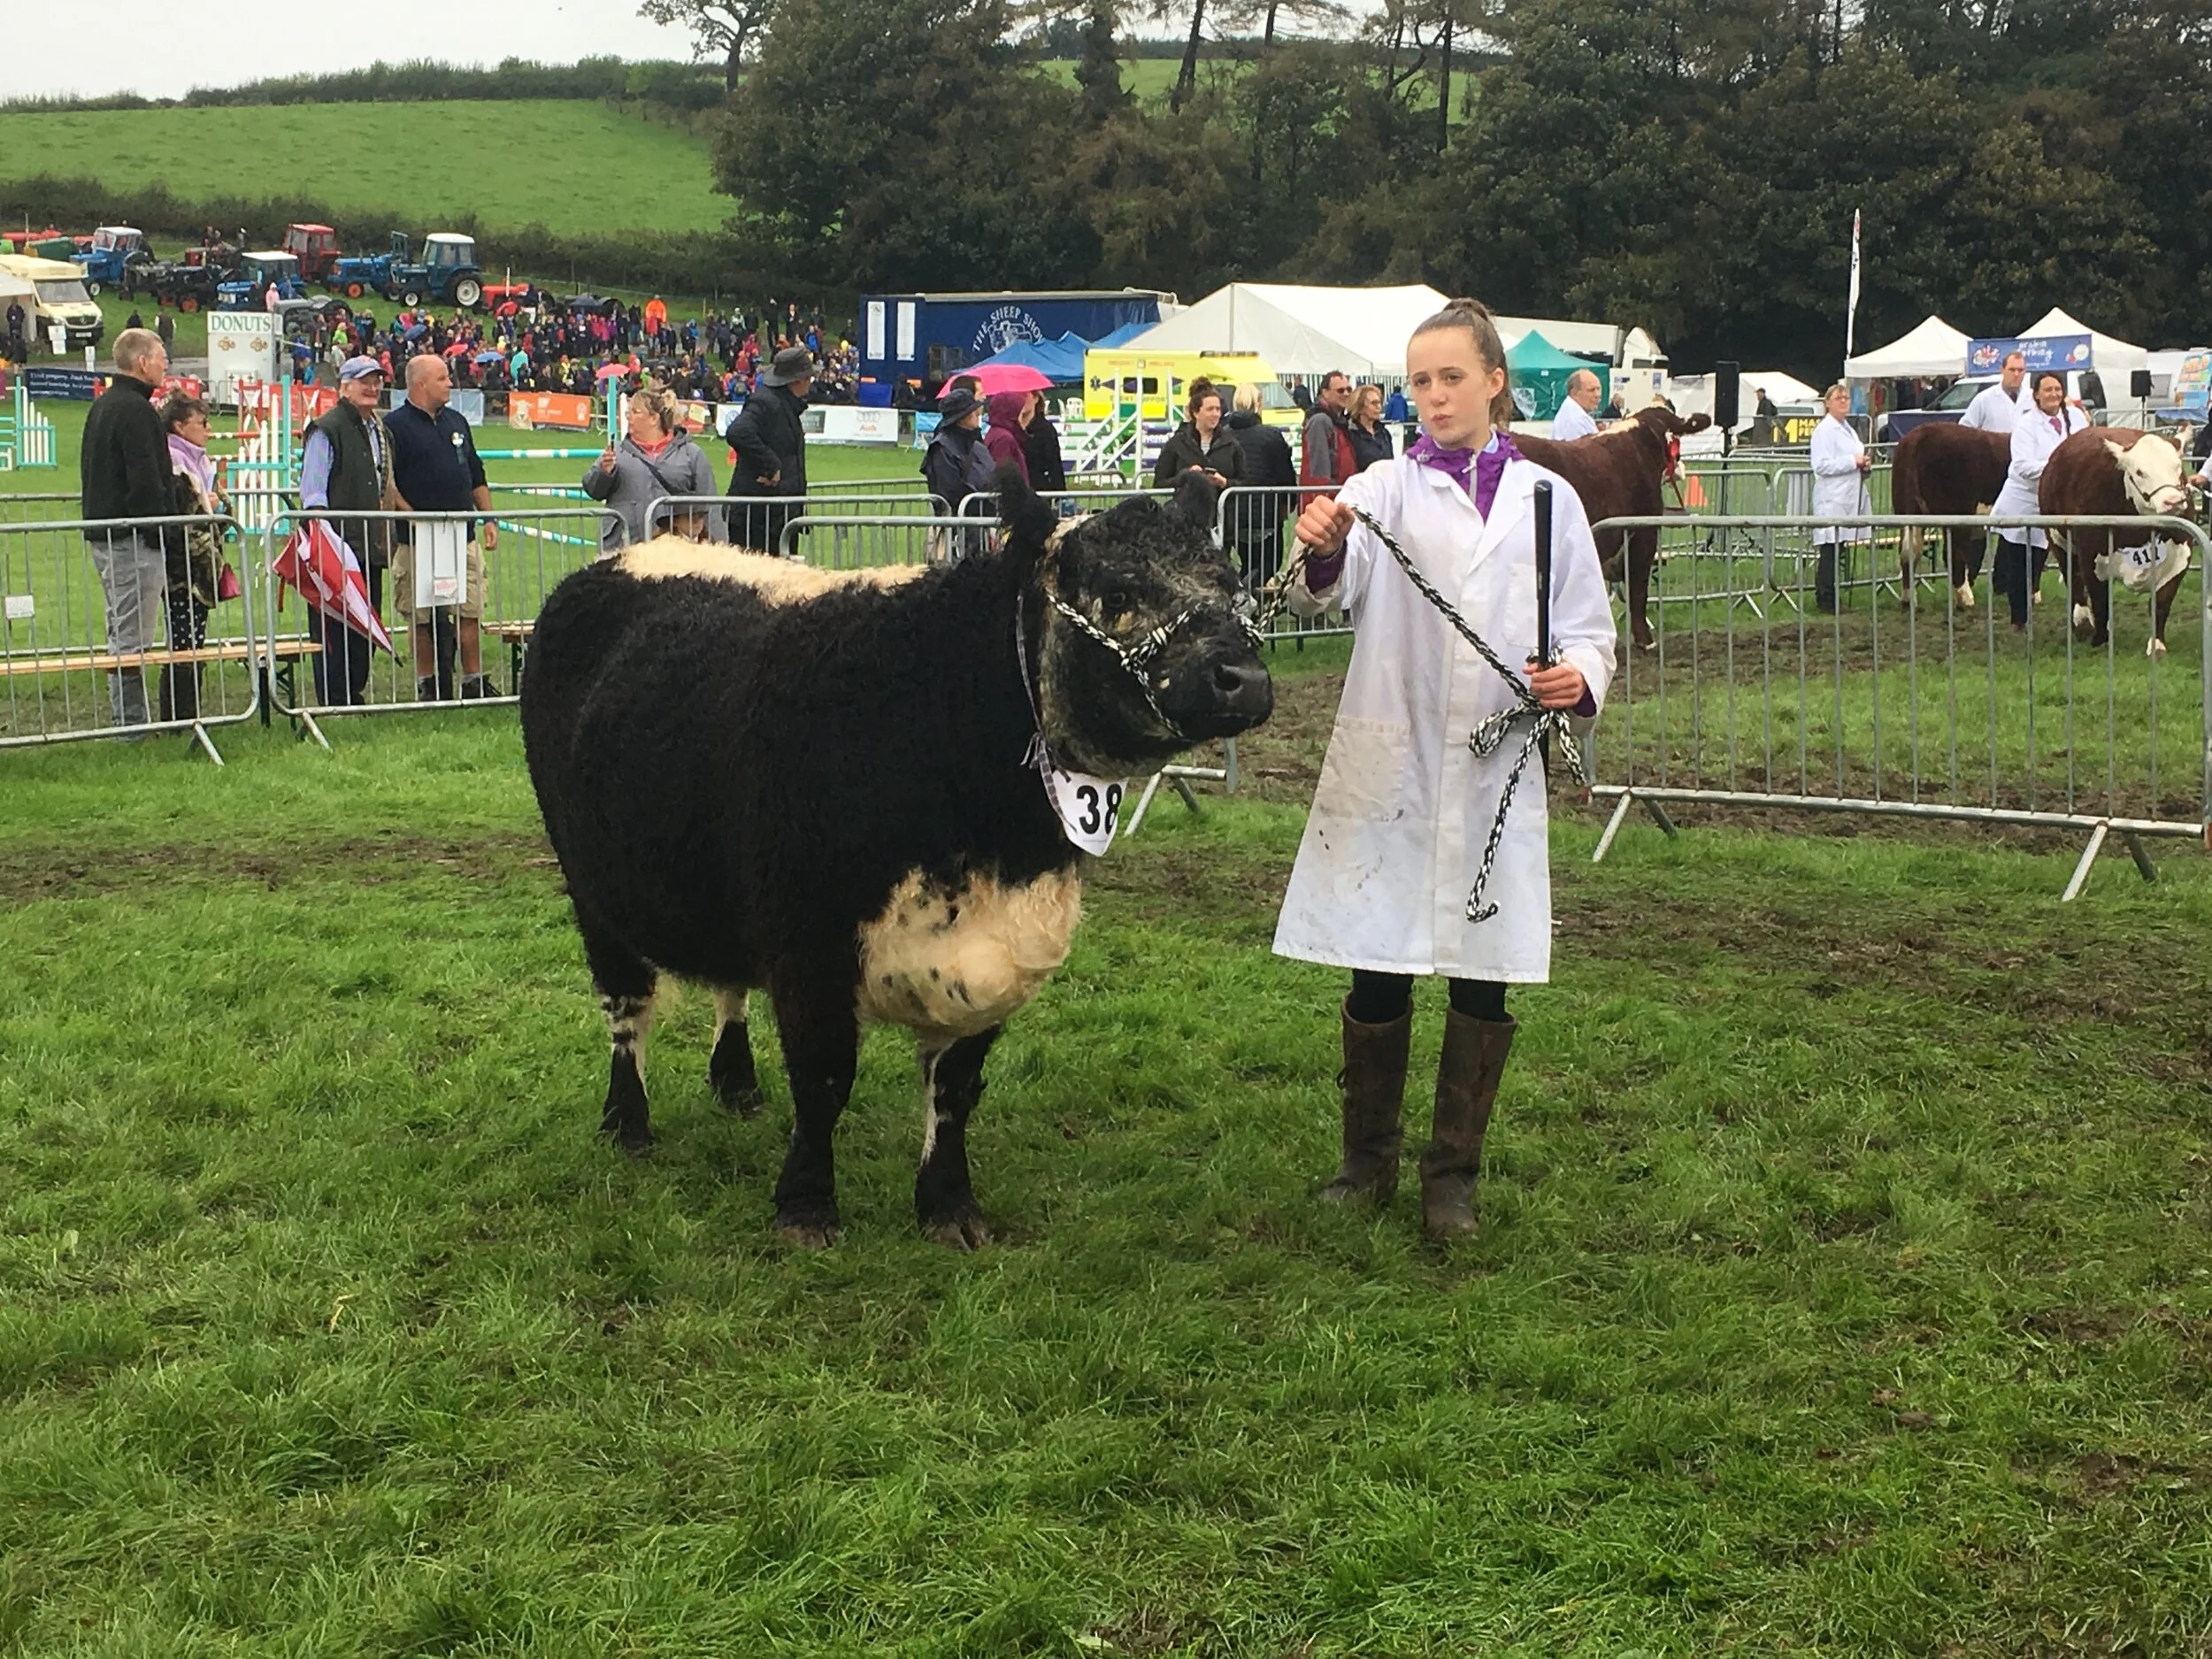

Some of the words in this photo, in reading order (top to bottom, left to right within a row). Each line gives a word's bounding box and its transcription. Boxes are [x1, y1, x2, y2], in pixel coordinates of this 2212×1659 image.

[211, 315, 271, 332] DONUTS
[972, 321, 988, 351] THE
[990, 305, 1022, 325] SHEEP
[1076, 782, 1123, 835] 38
